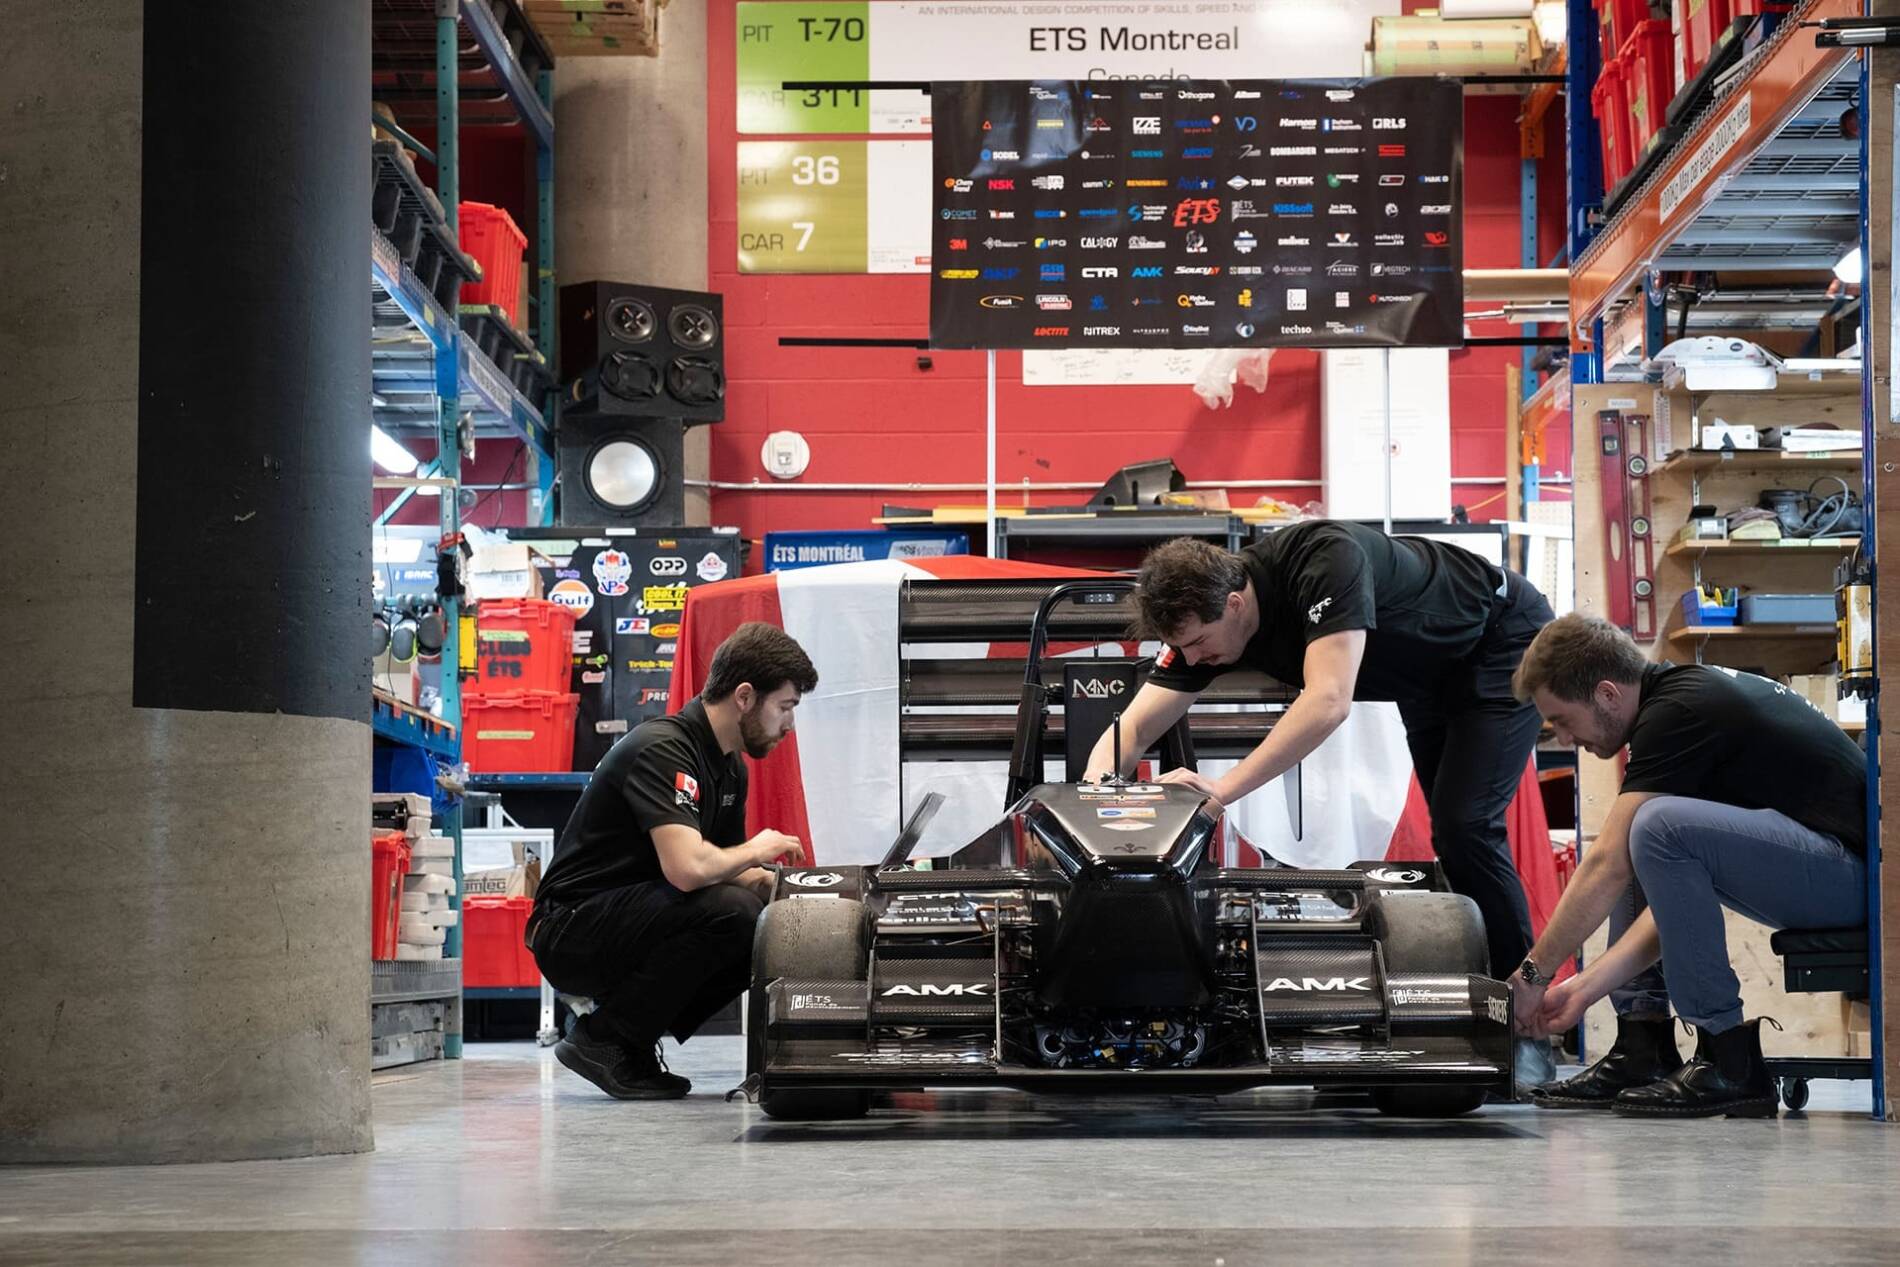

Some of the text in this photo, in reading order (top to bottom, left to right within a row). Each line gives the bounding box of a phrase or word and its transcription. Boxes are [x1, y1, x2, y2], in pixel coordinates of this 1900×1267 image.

[918, 7, 934, 15] AN
[937, 6, 1018, 15] INTERNATIONAL
[1022, 6, 1062, 14] DESIGN
[1065, 5, 1134, 14] COMPETITION
[1137, 5, 1151, 13] OF
[743, 18, 864, 42] PIT T-70
[1030, 26, 1239, 51] ETS Montreal
[1382, 118, 1406, 129] RLS
[792, 156, 840, 185] 36
[988, 179, 1014, 190] NSK
[1276, 177, 1314, 187] FUTEK
[1173, 198, 1219, 227] ÉTS
[741, 222, 815, 252] CAR 7
[950, 239, 967, 250] 3M
[1082, 267, 1118, 278] CTA
[1131, 266, 1163, 278] AMK
[1034, 327, 1069, 336] LOCTITE
[1083, 327, 1120, 336] NITREX
[1281, 325, 1312, 334] techso
[773, 543, 865, 563] ÉTS MONTRÉAL
[602, 580, 618, 593] VP
[551, 593, 590, 606] Gulf
[488, 656, 522, 677] ÉTS
[881, 984, 988, 996] AMK
[1264, 977, 1371, 991] AMK
[806, 994, 831, 1004] ÉTS
